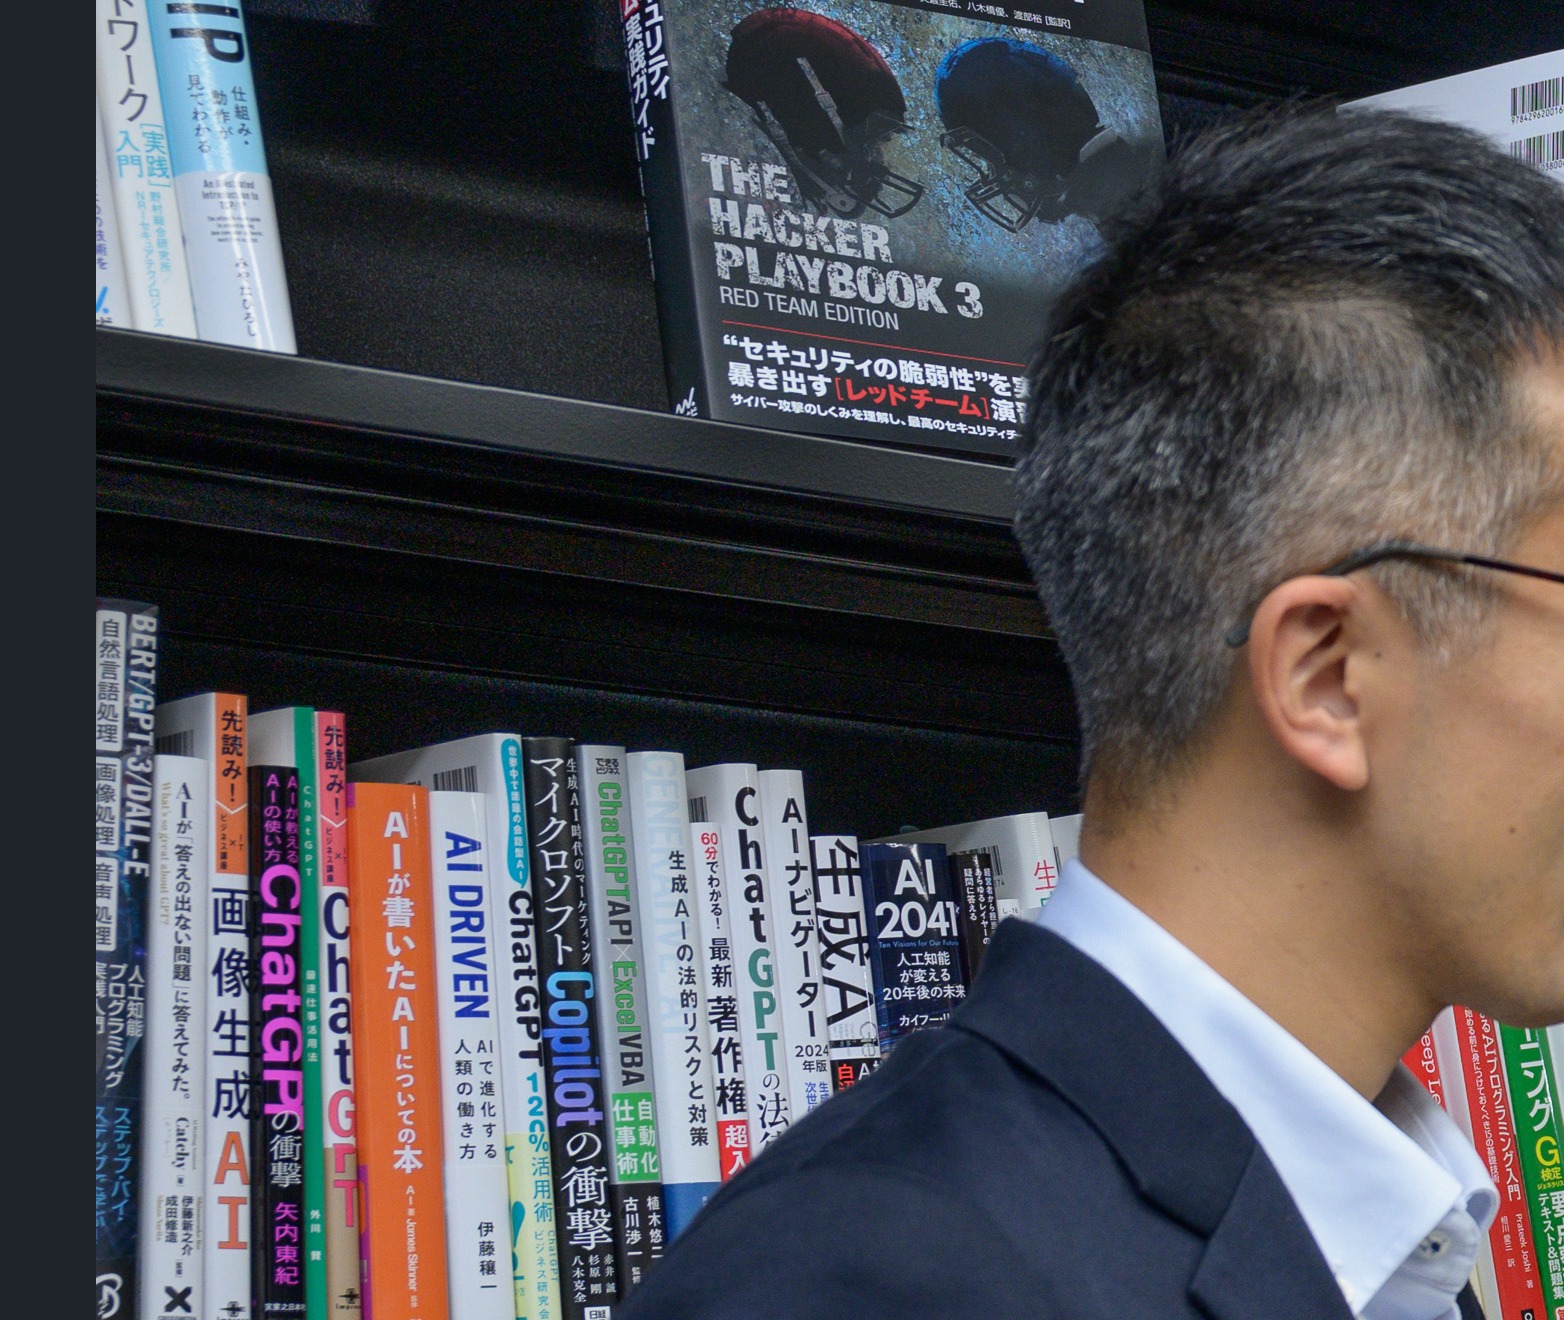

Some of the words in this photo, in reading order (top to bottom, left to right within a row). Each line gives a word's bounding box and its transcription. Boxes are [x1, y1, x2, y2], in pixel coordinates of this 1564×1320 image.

[116, 130, 144, 179] 入門
[701, 153, 793, 203] THE
[709, 197, 893, 264] HACKER
[714, 241, 950, 316] PLAYBOOK
[955, 281, 983, 321] 3
[719, 286, 760, 308] RED
[763, 292, 819, 319] TEAM
[824, 302, 900, 331] EDITION
[97, 617, 122, 745] 自然言語処理
[124, 612, 158, 879] BERT/GPT-3/DALL-E
[221, 710, 243, 802] 先読み！
[323, 725, 346, 817] 先読み！
[263, 773, 283, 862] AIの使い方
[303, 785, 314, 877] ChatGPT
[445, 830, 484, 873] AI
[530, 757, 575, 966] マイクロソフト
[566, 757, 592, 966] 生成AI時代のマーケティング
[894, 858, 937, 896] AI
[963, 867, 978, 922] 疑問に答える
[447, 883, 491, 1019] DRIVEN
[781, 797, 820, 1038] AIナビゲーター
[875, 900, 959, 940] 2041
[381, 811, 424, 1175] AIが書いたAIについての本
[507, 889, 544, 1068] ChatGPT
[708, 936, 732, 988] 最新
[883, 984, 967, 1001] 20年後の未来
[897, 951, 951, 967] 人工知能
[899, 968, 951, 984] が変える
[104, 963, 126, 1090] プログラミング
[126, 964, 146, 1039] 人工知能
[668, 850, 709, 1147] 生成AIの法的リスクと対策
[211, 886, 252, 1250] 画像生成AI
[707, 994, 747, 1116] 著作権
[794, 1044, 830, 1058] 2024
[802, 1060, 828, 1073] 年版
[454, 1038, 477, 1161] 人類の働き方
[476, 1039, 498, 1160] AIで進化する
[543, 970, 614, 1251] Copilotの衝撃
[612, 1098, 639, 1175] 仕事術
[636, 1098, 659, 1174] 自動化
[1536, 1135, 1561, 1167] G
[1540, 1167, 1563, 1180] 検定
[273, 1202, 299, 1286] 矢内東紀
[406, 1218, 418, 1253] James
[623, 1196, 643, 1257] 古川渉一
[1515, 1213, 1528, 1248] Prateek
[1521, 1248, 1533, 1273] Joshi
[407, 1253, 419, 1292] Skinner
[533, 1231, 551, 1320] ビジネス研究会
[588, 1254, 601, 1278] 杉原
